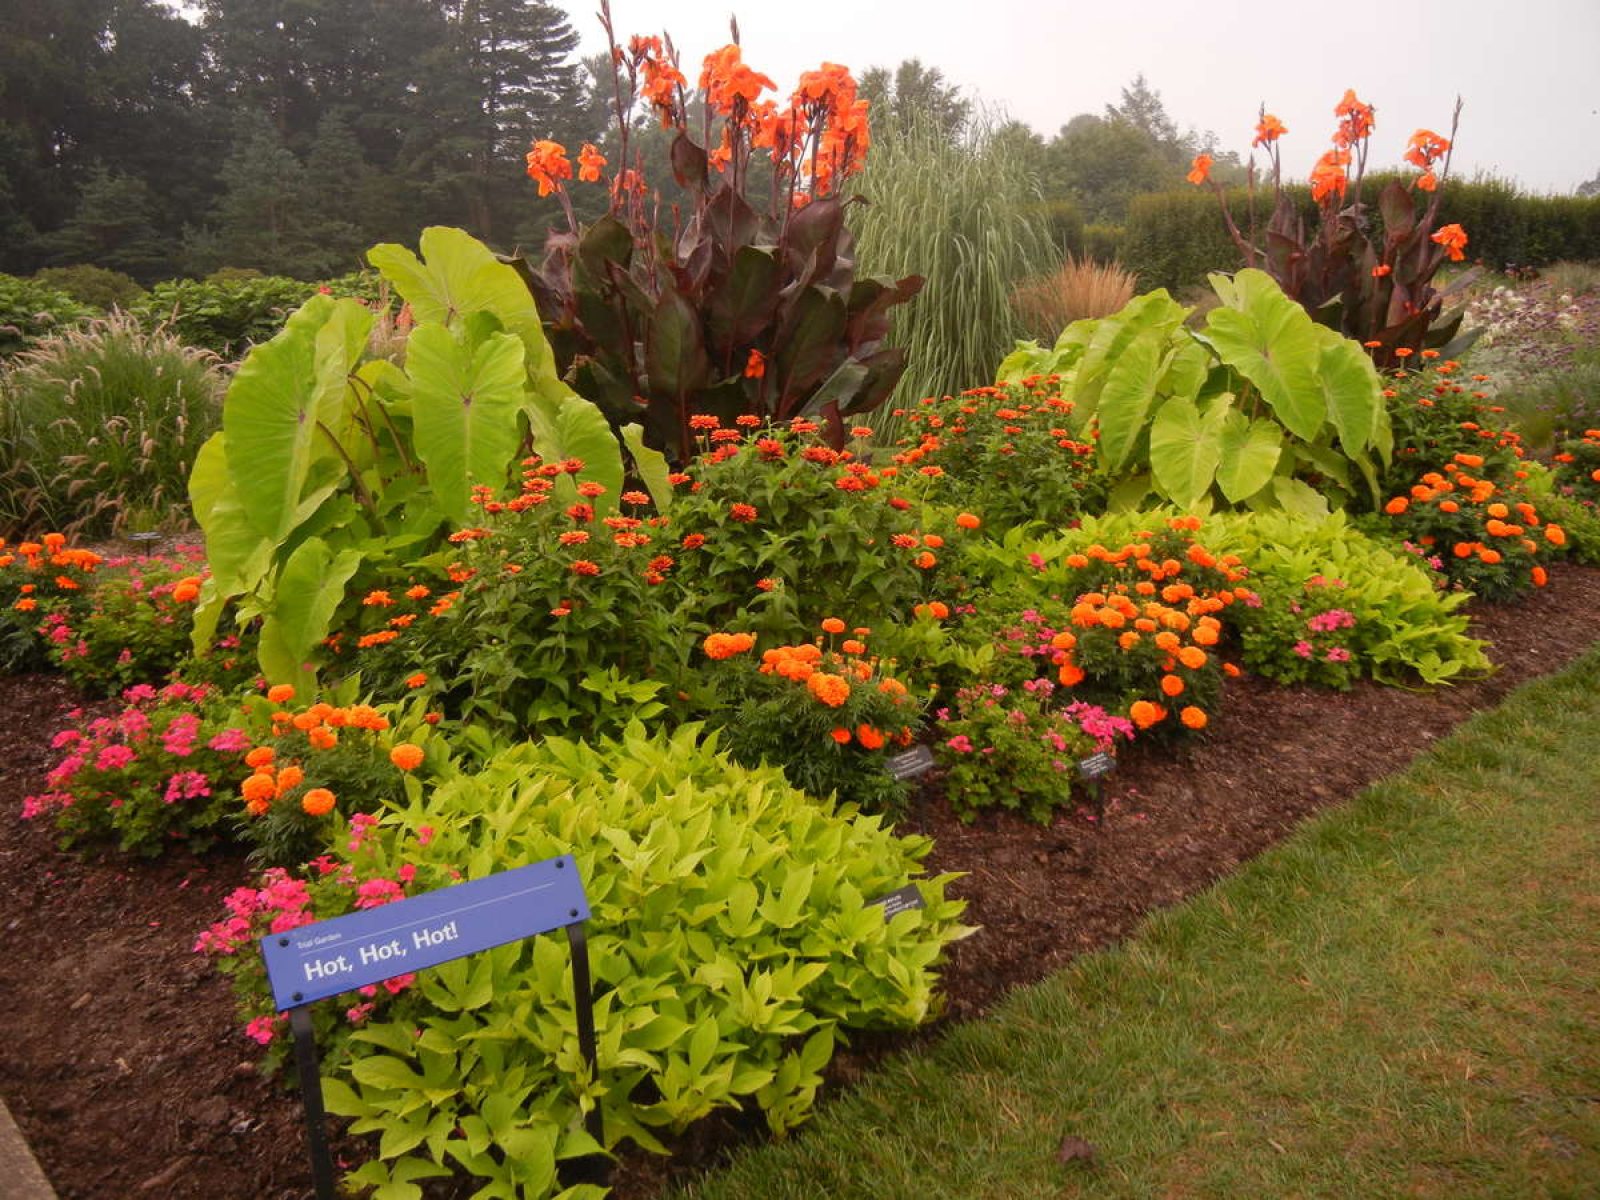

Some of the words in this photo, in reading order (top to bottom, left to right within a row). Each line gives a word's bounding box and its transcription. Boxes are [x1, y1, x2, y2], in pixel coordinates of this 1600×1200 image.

[304, 955, 353, 981] Hot,
[359, 939, 407, 965] Hot,
[412, 921, 459, 950] Hot!
